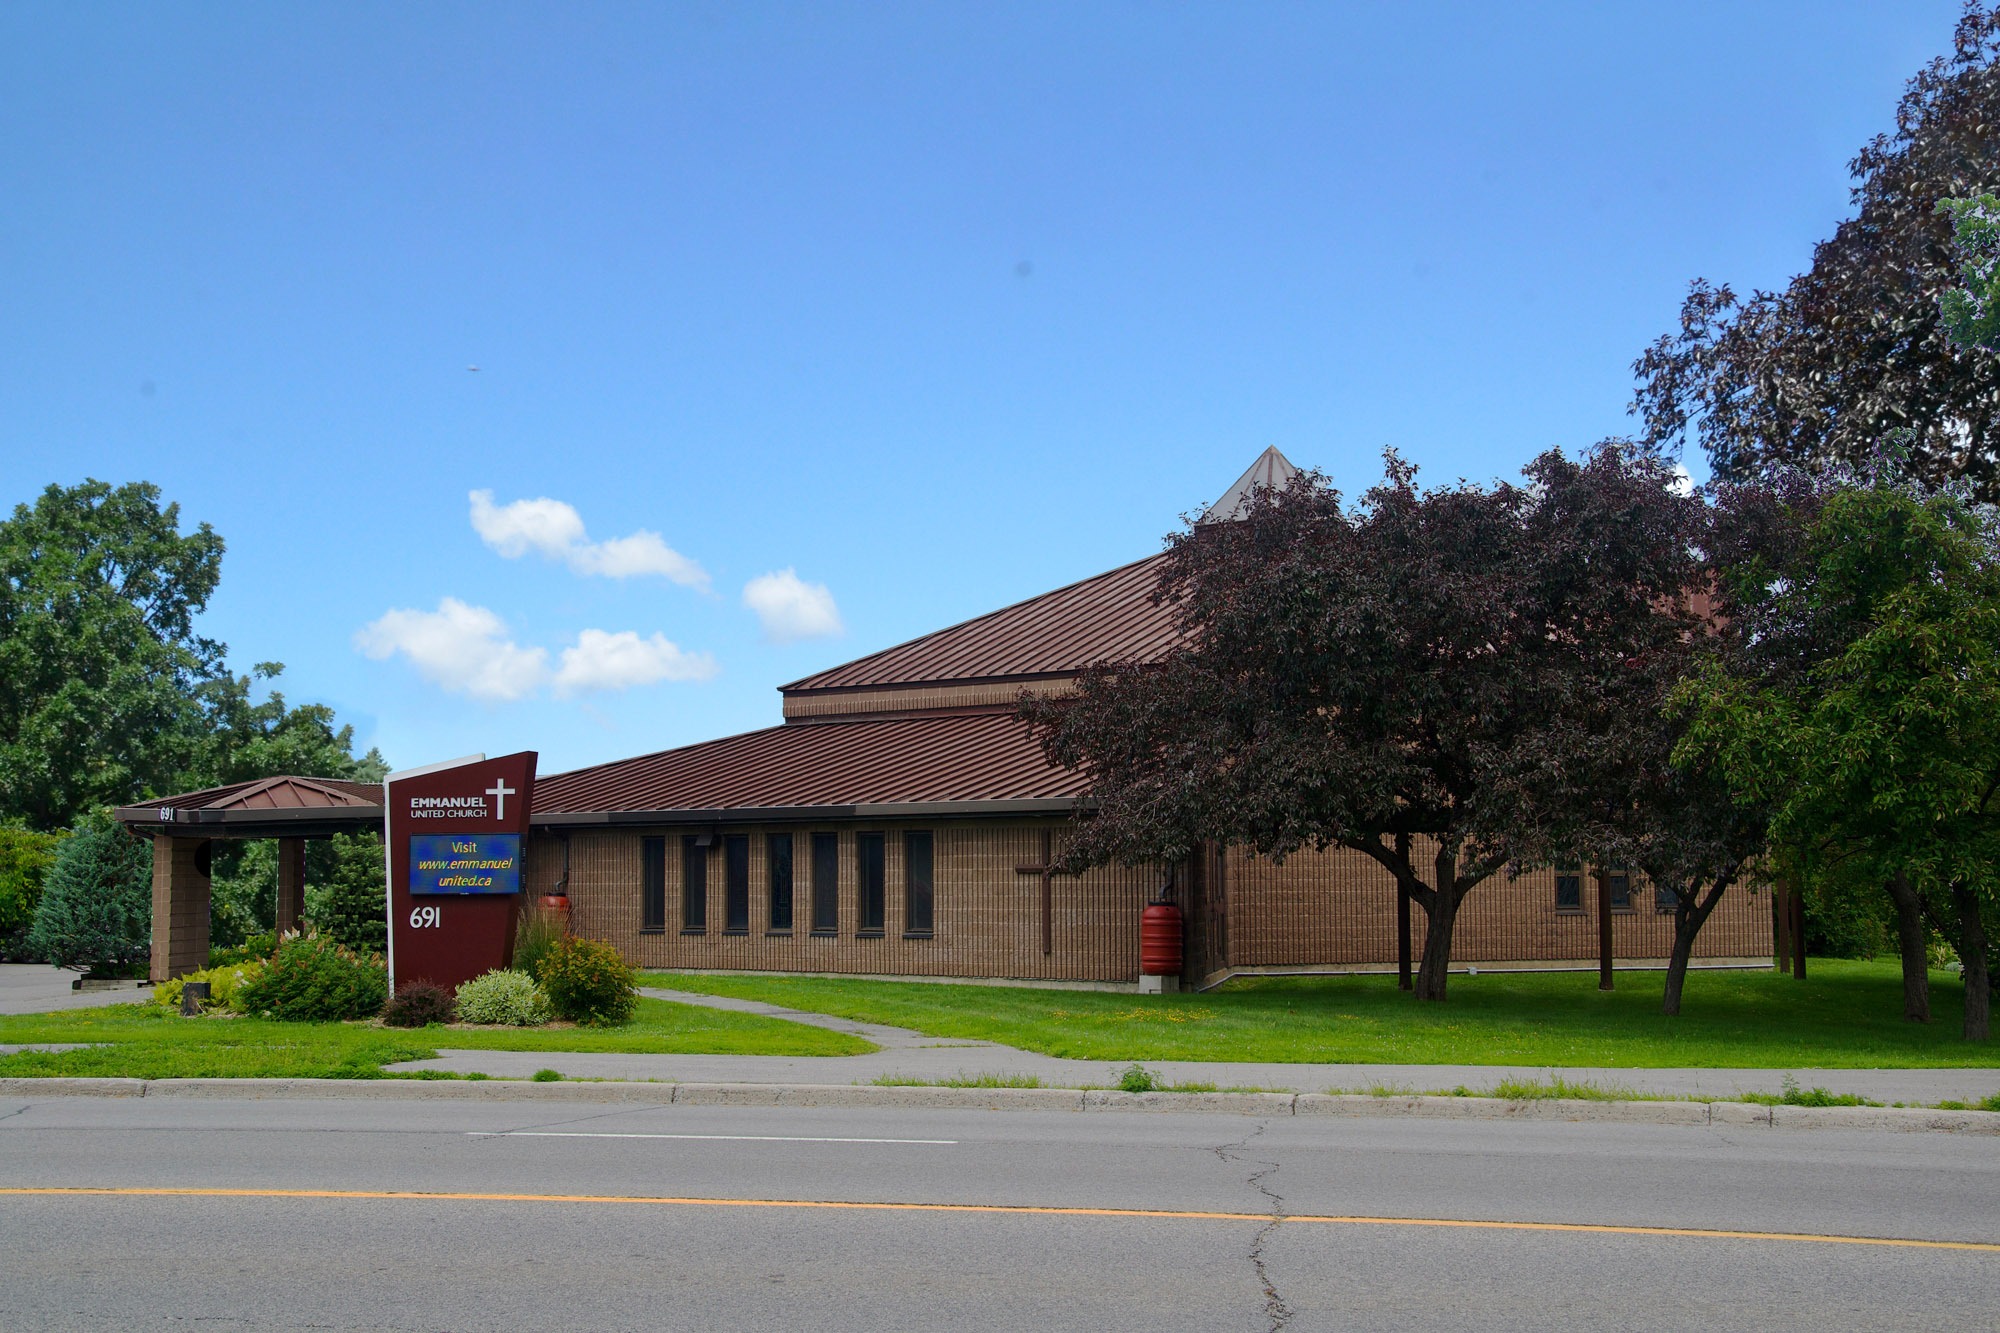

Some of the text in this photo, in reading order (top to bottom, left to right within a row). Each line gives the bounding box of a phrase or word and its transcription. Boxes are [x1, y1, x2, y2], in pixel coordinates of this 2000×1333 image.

[410, 797, 487, 808] EMMANUEL
[160, 807, 174, 821] 691
[410, 809, 487, 818] UNITED CHURCH
[452, 842, 477, 853] Visit
[419, 858, 512, 869] www.emmanuel
[439, 876, 492, 886] united.ca
[410, 906, 440, 928] 691
